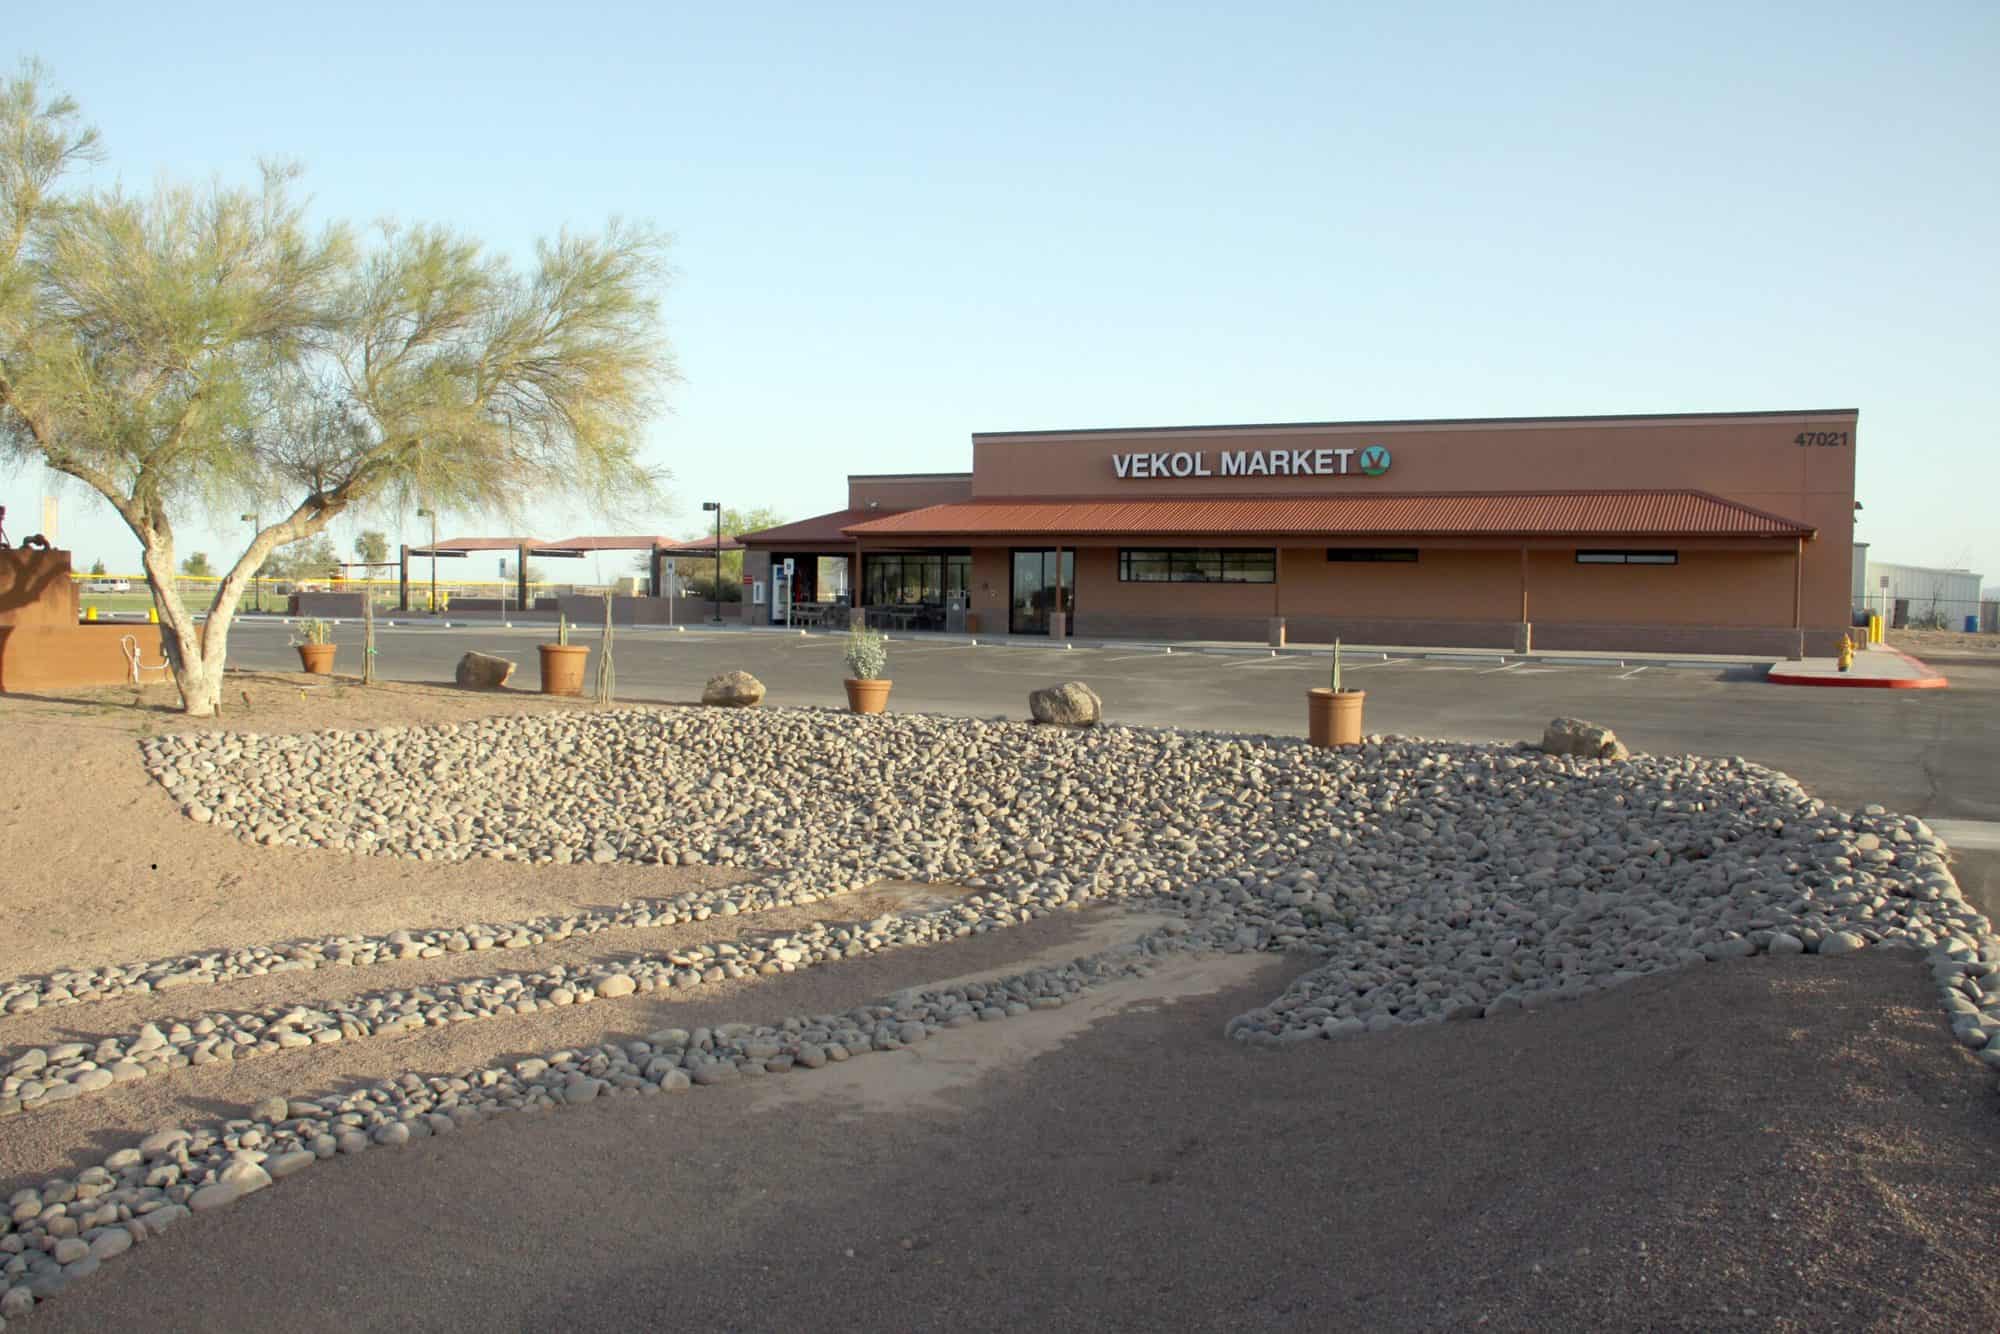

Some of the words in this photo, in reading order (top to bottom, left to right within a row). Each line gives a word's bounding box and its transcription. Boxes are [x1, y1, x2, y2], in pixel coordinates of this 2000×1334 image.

[1794, 432, 1849, 447] 47021
[1112, 451, 1211, 478] VEKOL
[1220, 448, 1355, 476] MARKET
